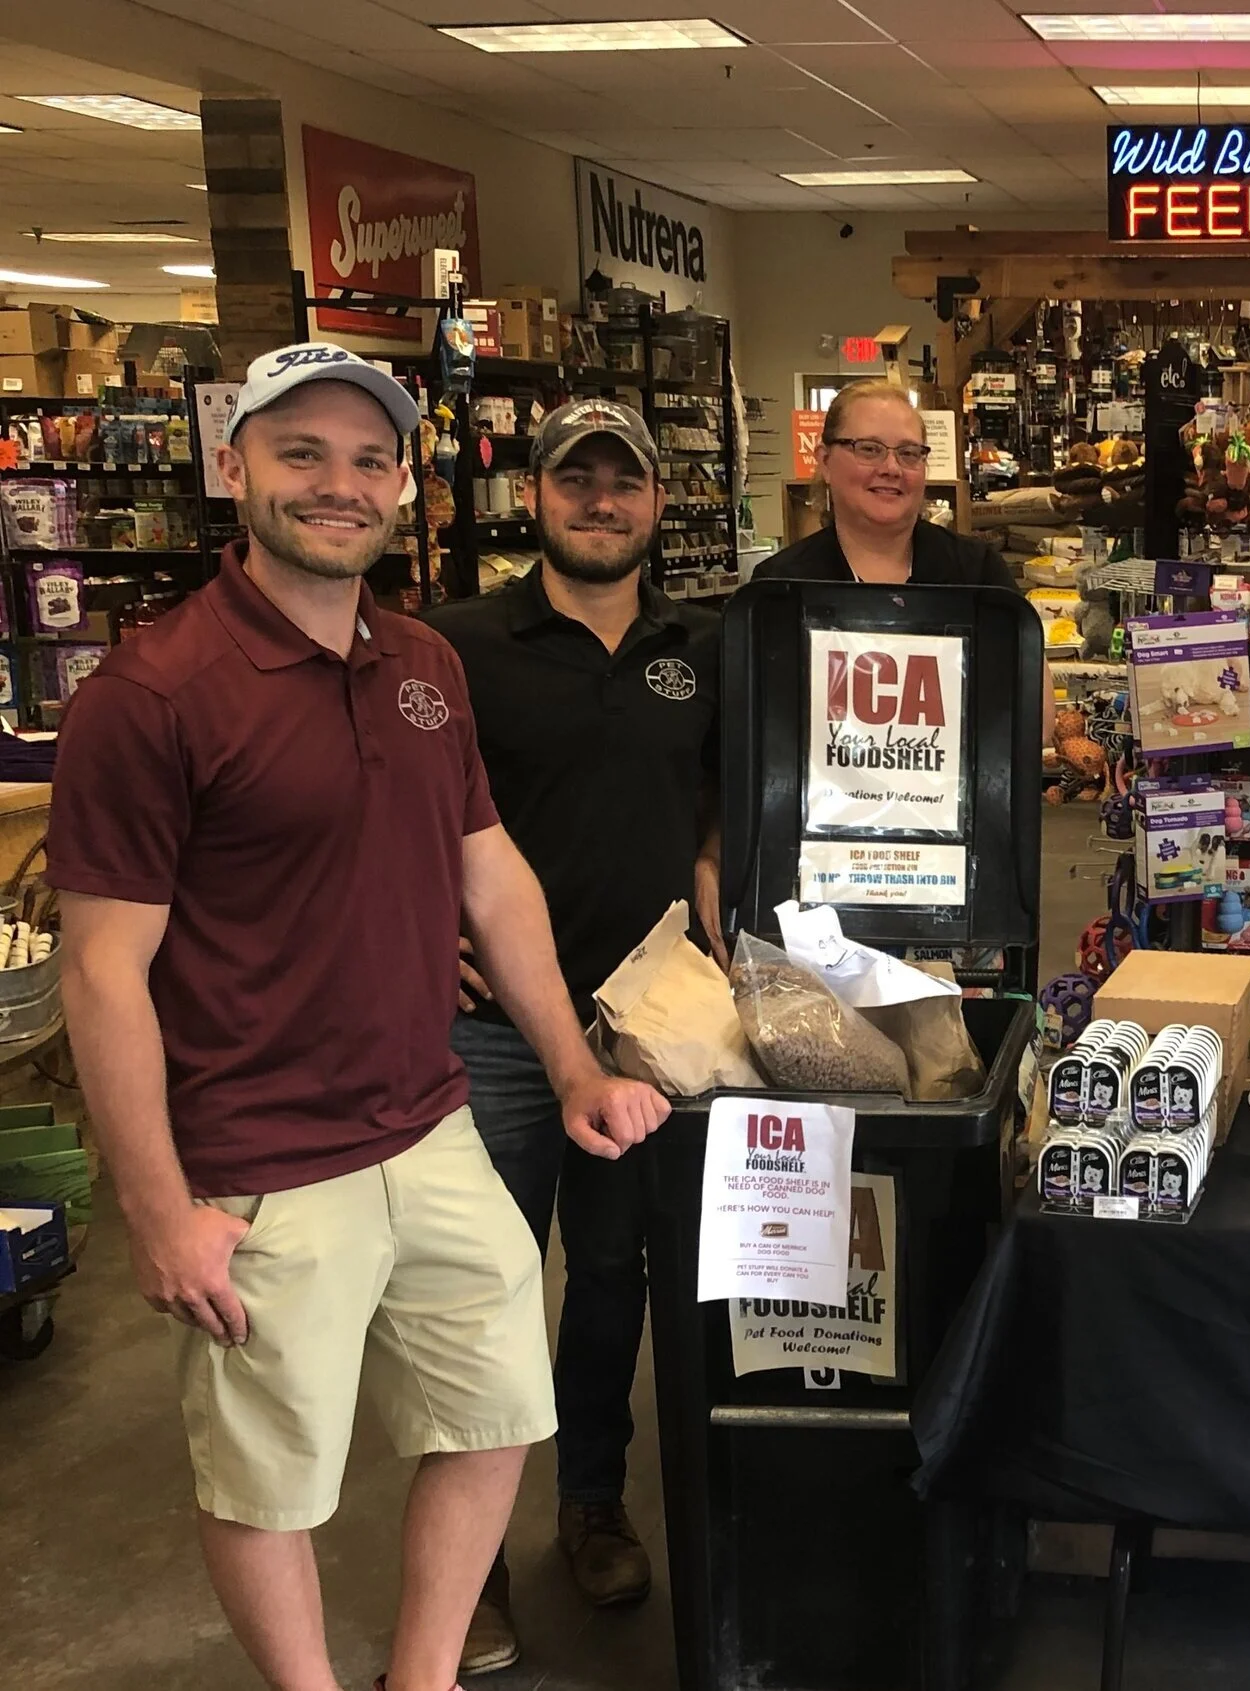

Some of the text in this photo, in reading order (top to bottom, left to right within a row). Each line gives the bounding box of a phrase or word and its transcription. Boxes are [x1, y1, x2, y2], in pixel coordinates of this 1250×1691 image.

[1113, 128, 1207, 175] Wild
[330, 185, 467, 280] Supersweet
[590, 171, 704, 283] Nutrena
[405, 683, 426, 693] PET
[827, 650, 946, 727] ICA
[410, 710, 444, 726] STUFF
[828, 723, 940, 750] Your Local
[826, 743, 945, 772] FOODSHELF
[893, 850, 921, 861] SHELF
[849, 873, 882, 884] THROW
[885, 874, 914, 884] TRASH
[916, 874, 936, 885] INTO
[940, 875, 956, 885] BIN
[1226, 870, 1240, 880] NG
[914, 949, 953, 960] SALMON
[747, 1113, 806, 1152] ICA
[747, 1149, 803, 1163] Your Local
[746, 1158, 806, 1173] FOODSHELF
[723, 1175, 739, 1183] THE
[742, 1175, 756, 1183] ICA
[759, 1176, 784, 1185] FOOD
[786, 1178, 809, 1187] SHELF
[821, 1181, 830, 1189] IN
[767, 1184, 803, 1193] CANNED
[805, 1186, 825, 1195] DOG
[762, 1191, 790, 1200] FOOD.
[747, 1205, 770, 1213] HOW
[772, 1206, 790, 1214] YOU
[792, 1207, 811, 1216] CAN
[813, 1209, 835, 1218] HELP!
[739, 1297, 886, 1325] FOODSHELF
[744, 1326, 882, 1347] Pet Food Donations
[783, 1341, 851, 1356] Welcome!
